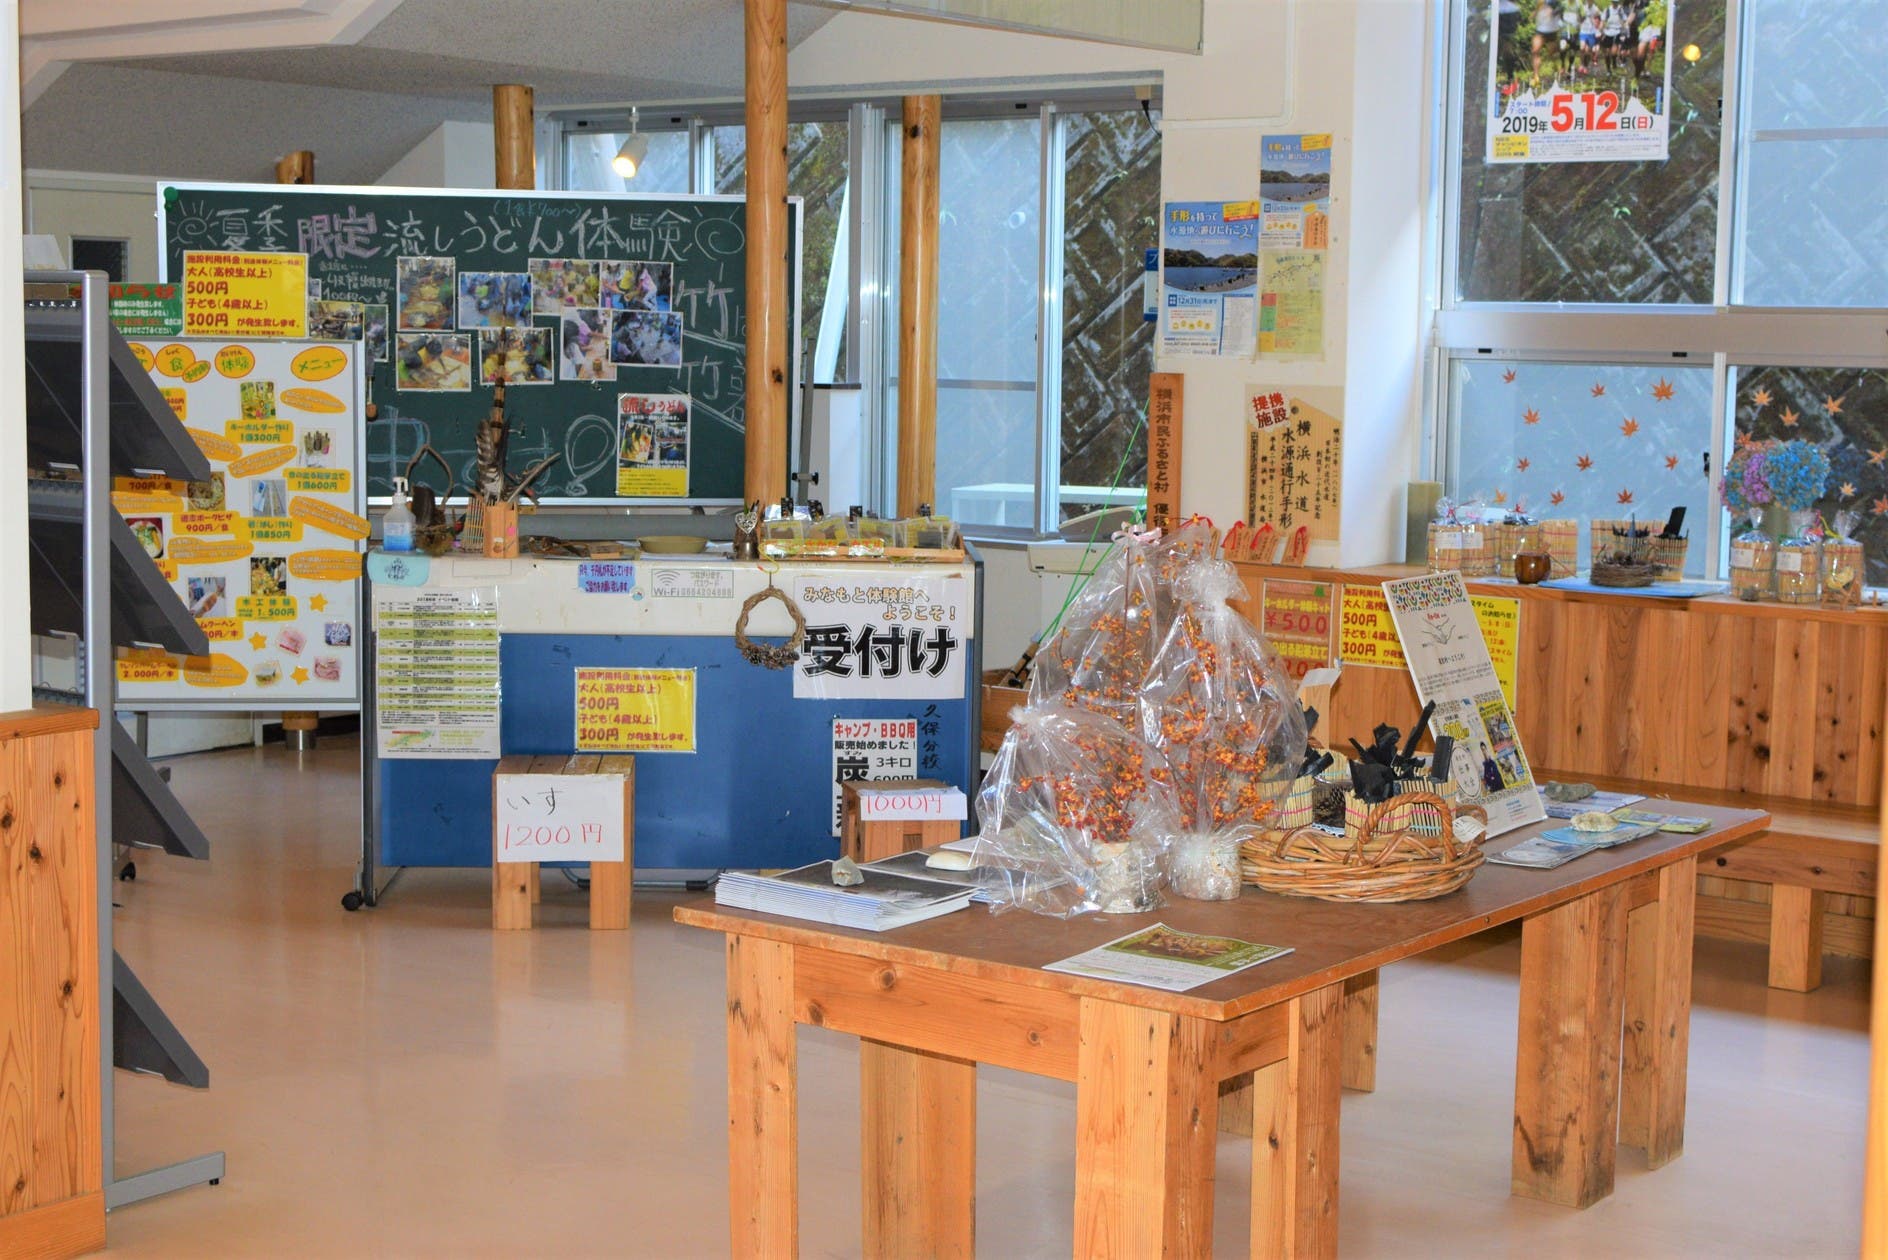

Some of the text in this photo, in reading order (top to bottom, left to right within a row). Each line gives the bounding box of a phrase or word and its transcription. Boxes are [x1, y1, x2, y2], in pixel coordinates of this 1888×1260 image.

[187, 267, 273, 279] 大人（高校生以上）
[187, 281, 229, 295] 500円
[187, 298, 269, 310] 子ども（4歳以上）
[187, 312, 300, 328] 300円 が発生致します。
[299, 357, 343, 373] メニュー
[622, 396, 685, 414] 流しうどん
[1252, 391, 1285, 412] 提携
[1256, 407, 1289, 429] 施設
[1154, 387, 1173, 494] 横浜市民ふるさと村
[1294, 418, 1312, 513] 横浜水道
[1278, 426, 1296, 530] 水源通行手形
[653, 587, 680, 596] Wi-Fi
[803, 586, 930, 604] みなもと体験館へ
[882, 604, 957, 622] ようこそ！
[1343, 612, 1378, 628] 500円
[1342, 628, 1401, 643] 子ども（4歳以
[801, 623, 959, 680] 受付け
[1342, 643, 1377, 657] 300円
[579, 683, 662, 694] 大人（高校生以上）
[578, 697, 619, 710] 500円
[579, 713, 658, 725] 子ども（4歳以上）
[579, 728, 619, 741] 300円
[834, 721, 916, 739] キャンプ・BBQ用
[920, 703, 943, 771] 久保分校
[834, 740, 916, 751] 販売始めました！
[875, 756, 912, 768] 3キロ
[506, 786, 565, 816] いす
[504, 822, 602, 850] 1200円
